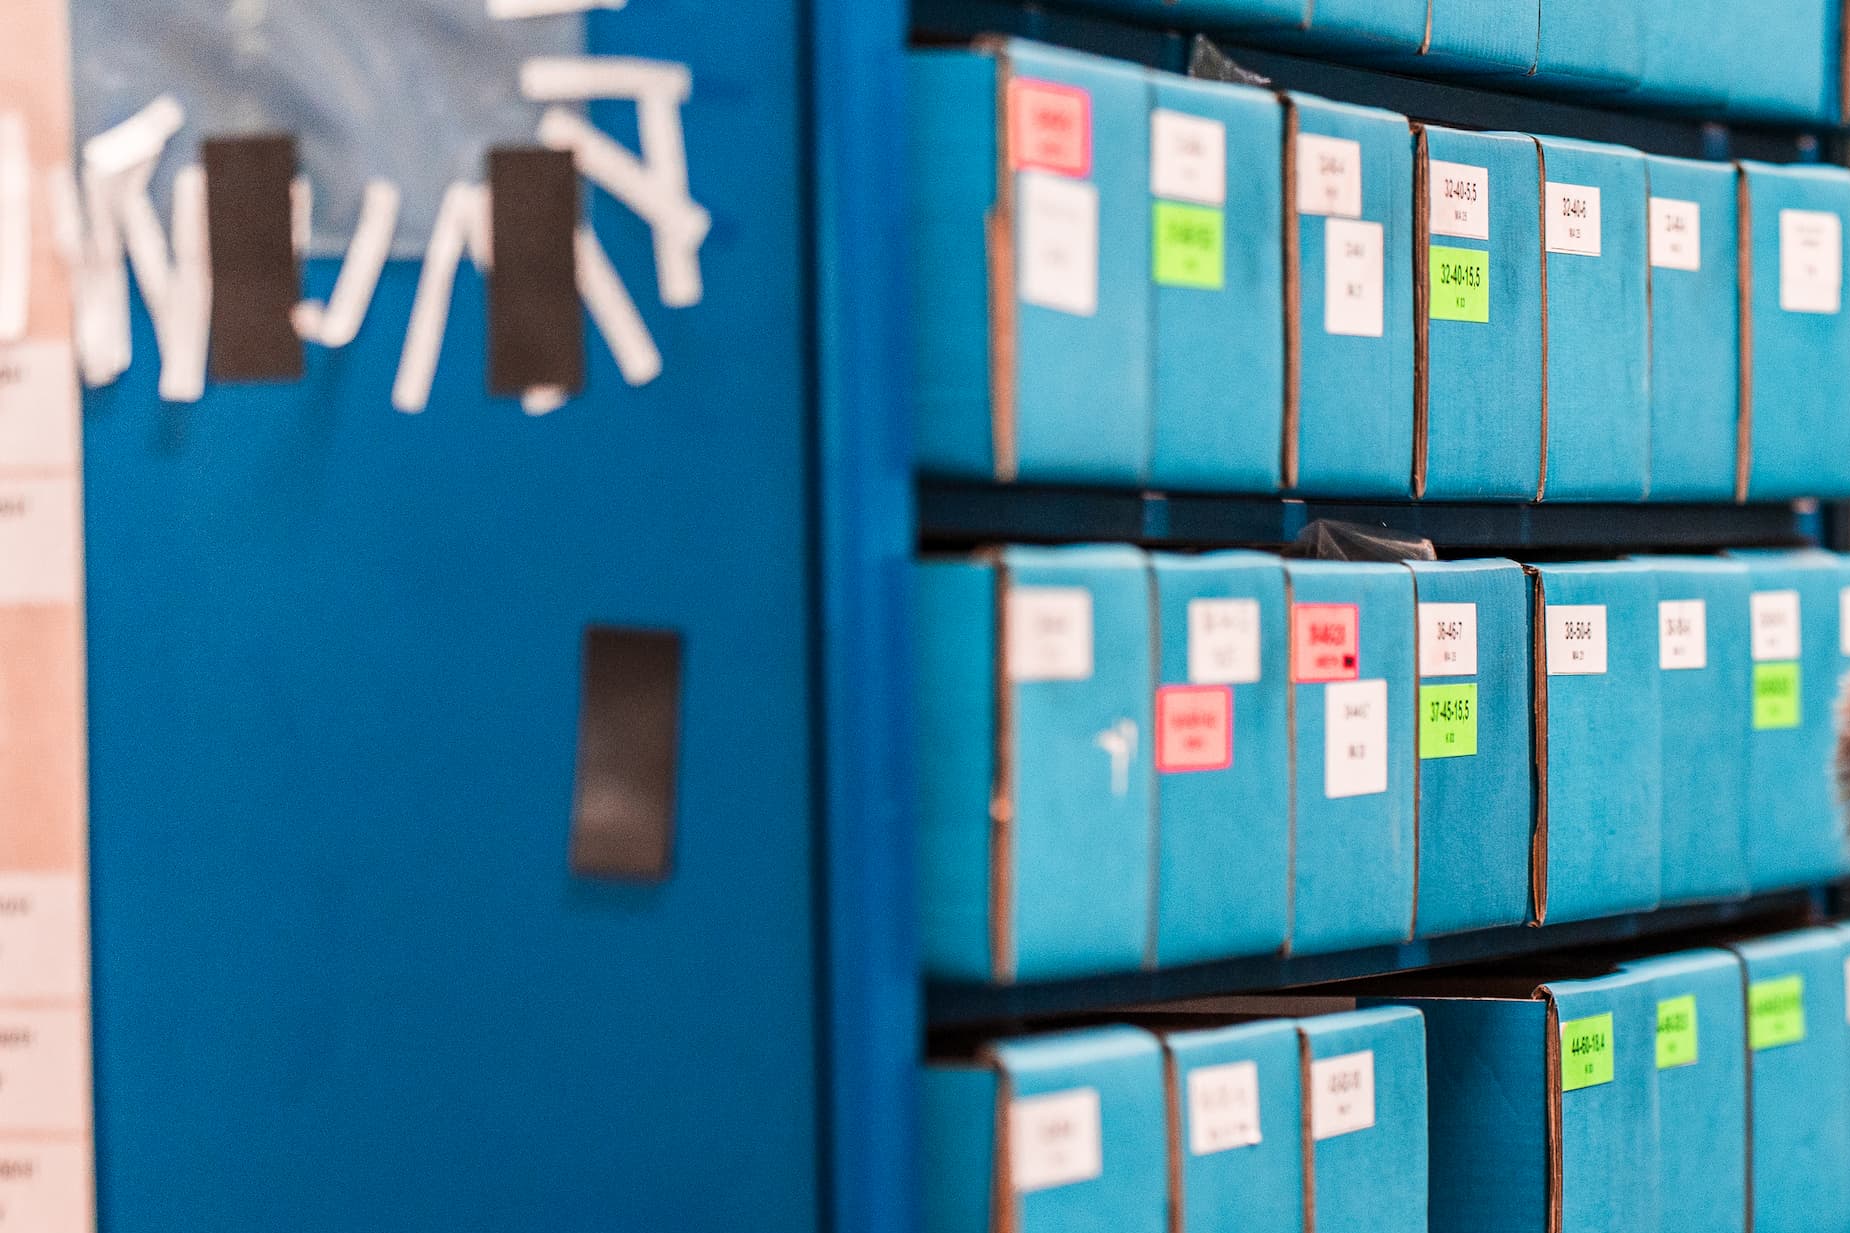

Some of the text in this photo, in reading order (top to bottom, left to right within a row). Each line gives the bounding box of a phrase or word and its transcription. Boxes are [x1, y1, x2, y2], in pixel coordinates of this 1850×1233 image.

[1445, 179, 1476, 201] 32-40-5,5
[1441, 264, 1480, 289] 32-40-15,5
[1431, 699, 1469, 724] 37-45-15,5
